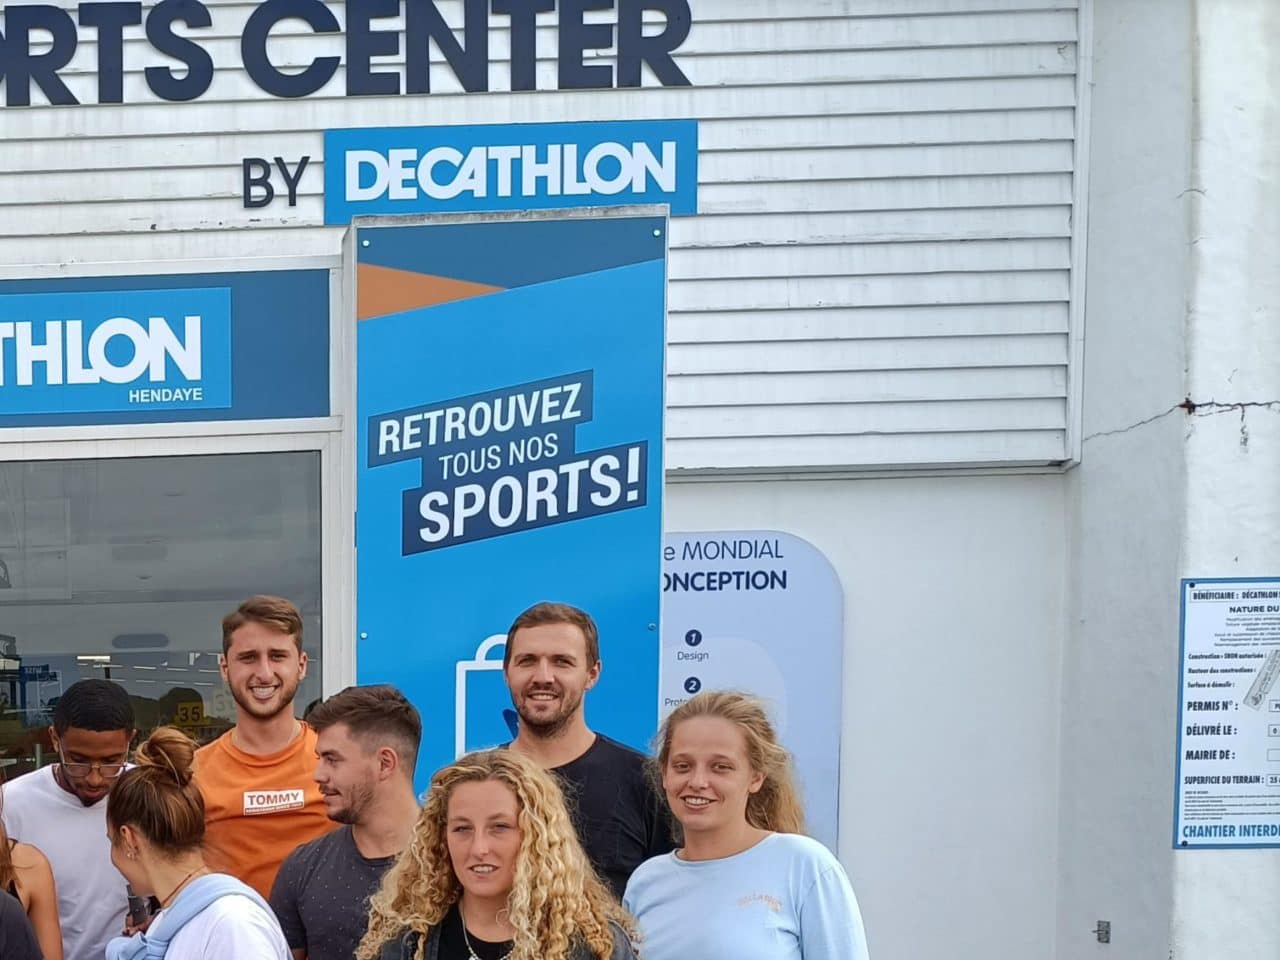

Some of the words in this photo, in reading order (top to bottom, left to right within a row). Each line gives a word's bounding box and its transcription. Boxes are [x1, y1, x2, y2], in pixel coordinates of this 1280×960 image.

[241, 0, 693, 98] CENTER
[242, 156, 309, 208] BY
[345, 141, 676, 202] DECATHLON
[128, 387, 203, 403] HENDAYE
[378, 382, 582, 456] RETROUVEZ
[439, 444, 503, 481] TOUS
[508, 433, 559, 466] NOS
[419, 447, 640, 543] SPORTS!
[682, 540, 784, 560] MONDIAL
[1229, 605, 1265, 613] NATURE
[677, 651, 709, 662] Design
[1187, 701, 1220, 711] PERMIS
[180, 706, 200, 722] 35
[1186, 722, 1221, 736] DÉLIVRÉ
[1223, 725, 1232, 735] LE
[1186, 750, 1217, 760] MAIRIE
[1219, 749, 1230, 760] DE
[1184, 776, 1220, 784] SUPERFICIE
[1222, 775, 1231, 784] DU
[1232, 775, 1260, 784] TERRAIN
[247, 792, 300, 806] TOMMY
[1183, 825, 1236, 838] CHANTIER
